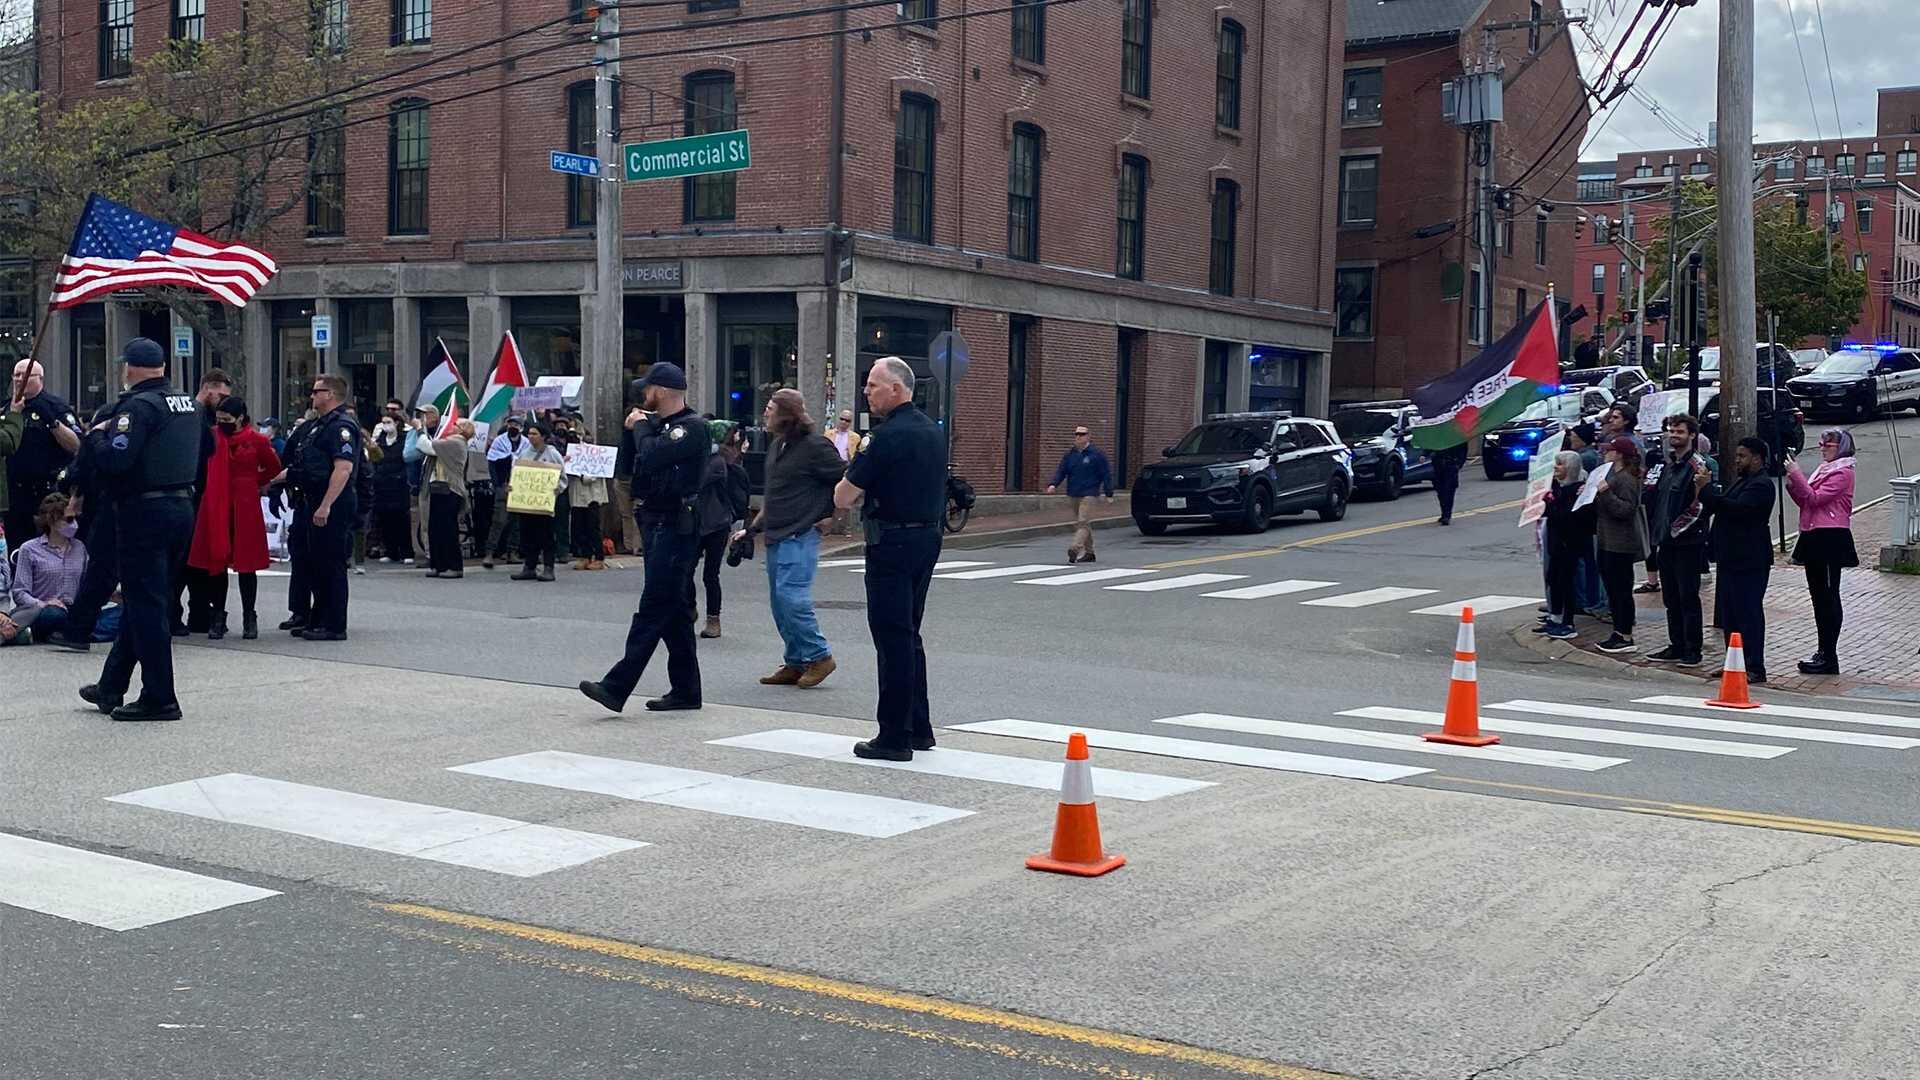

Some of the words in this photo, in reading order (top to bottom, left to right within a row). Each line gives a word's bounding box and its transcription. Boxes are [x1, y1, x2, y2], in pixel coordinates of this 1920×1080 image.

[553, 155, 583, 171] PEARL
[630, 141, 725, 173] Commercial
[729, 139, 745, 162] St
[637, 267, 680, 281] PEARCE
[165, 396, 195, 412] POLICE
[576, 444, 607, 456] STOP
[570, 464, 606, 475] GAZA
[513, 470, 555, 486] HUNGER
[527, 495, 553, 507] GAZA
